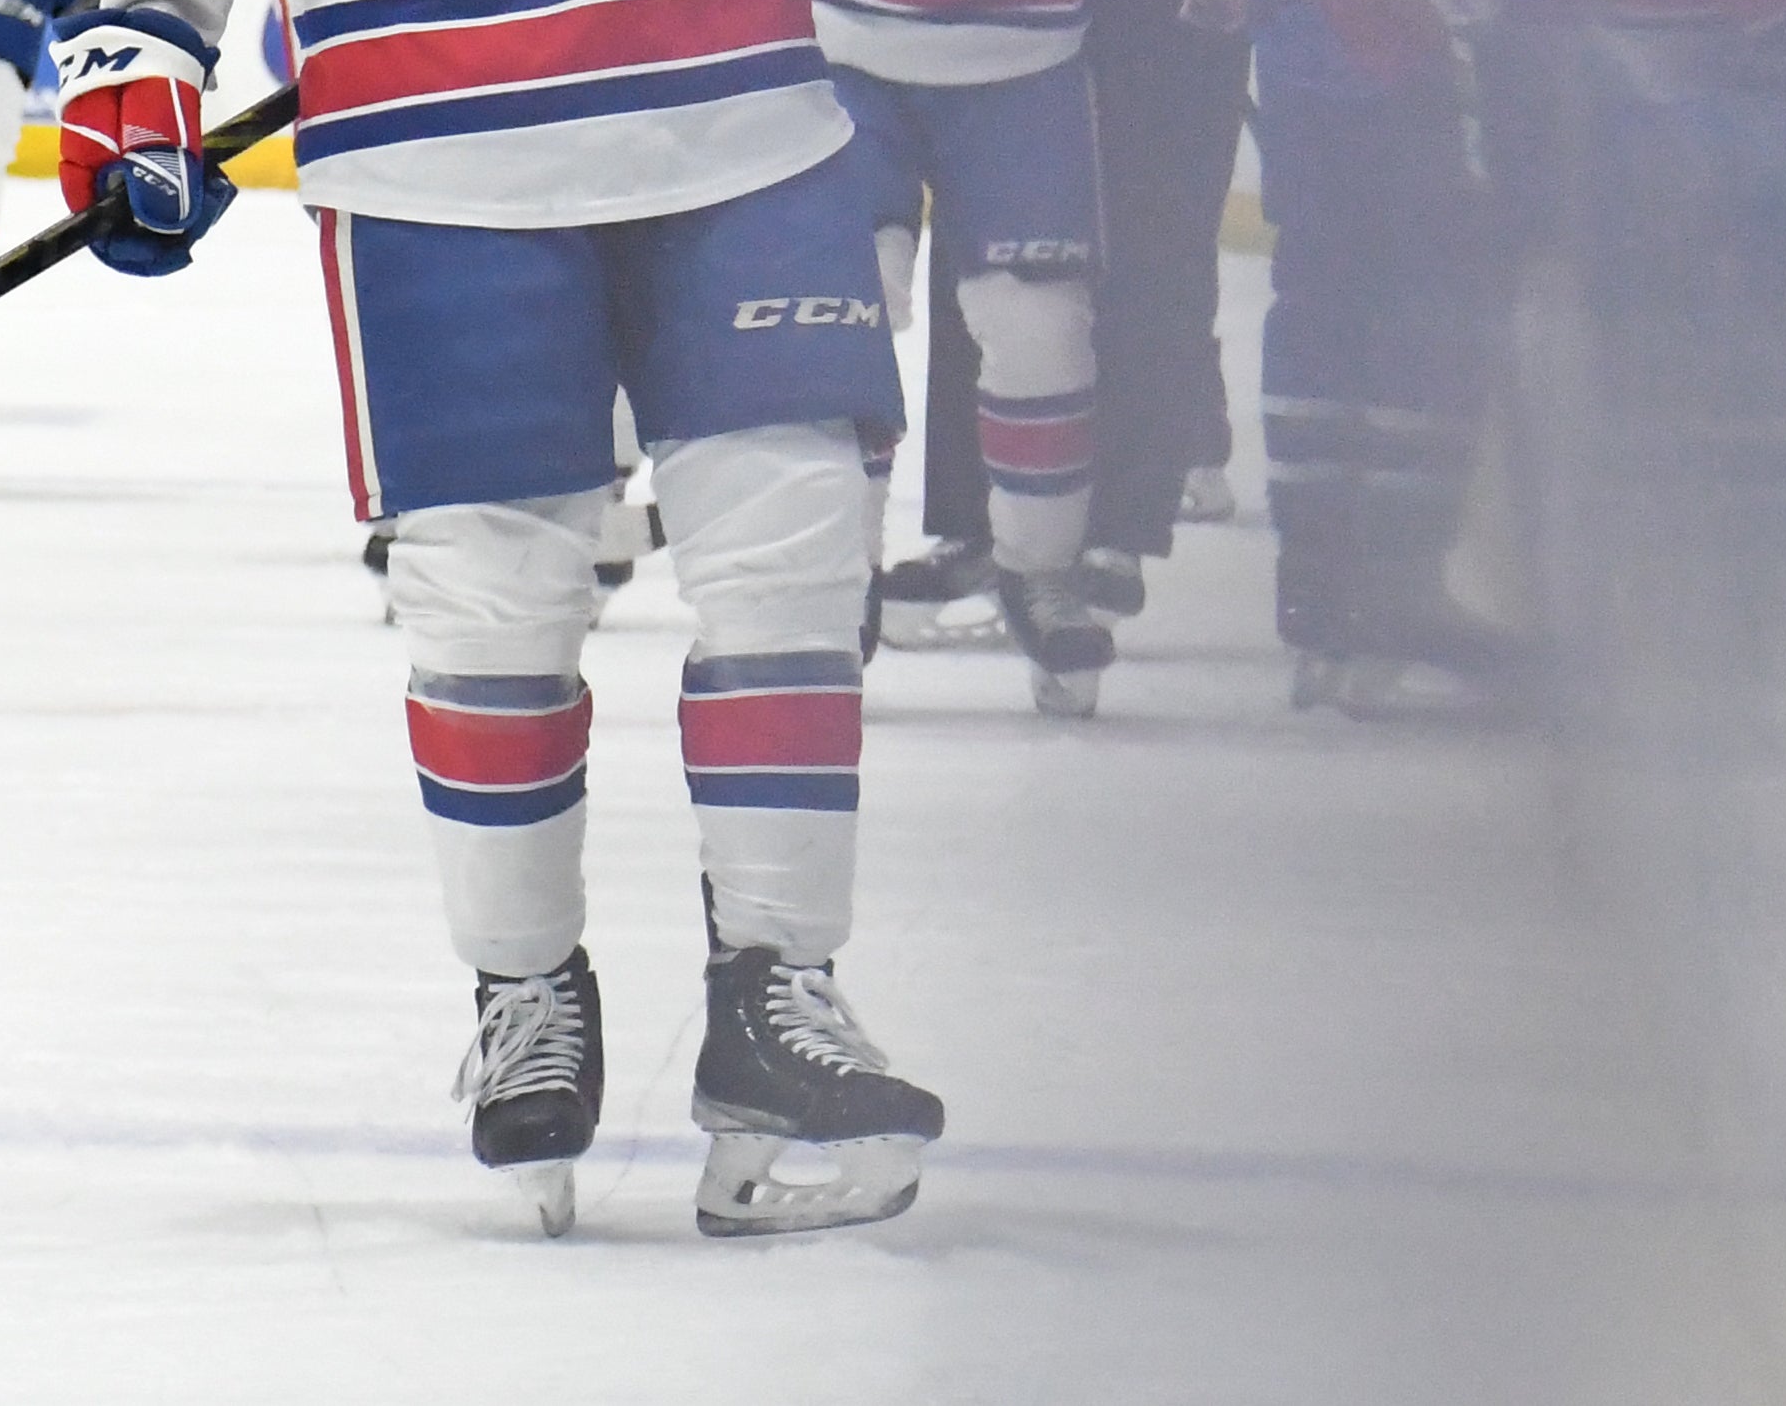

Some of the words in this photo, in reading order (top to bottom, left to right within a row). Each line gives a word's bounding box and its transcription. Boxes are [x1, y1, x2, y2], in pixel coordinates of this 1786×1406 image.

[131, 166, 177, 196] CCM
[985, 240, 1089, 265] CCM
[733, 296, 881, 330] CCM
